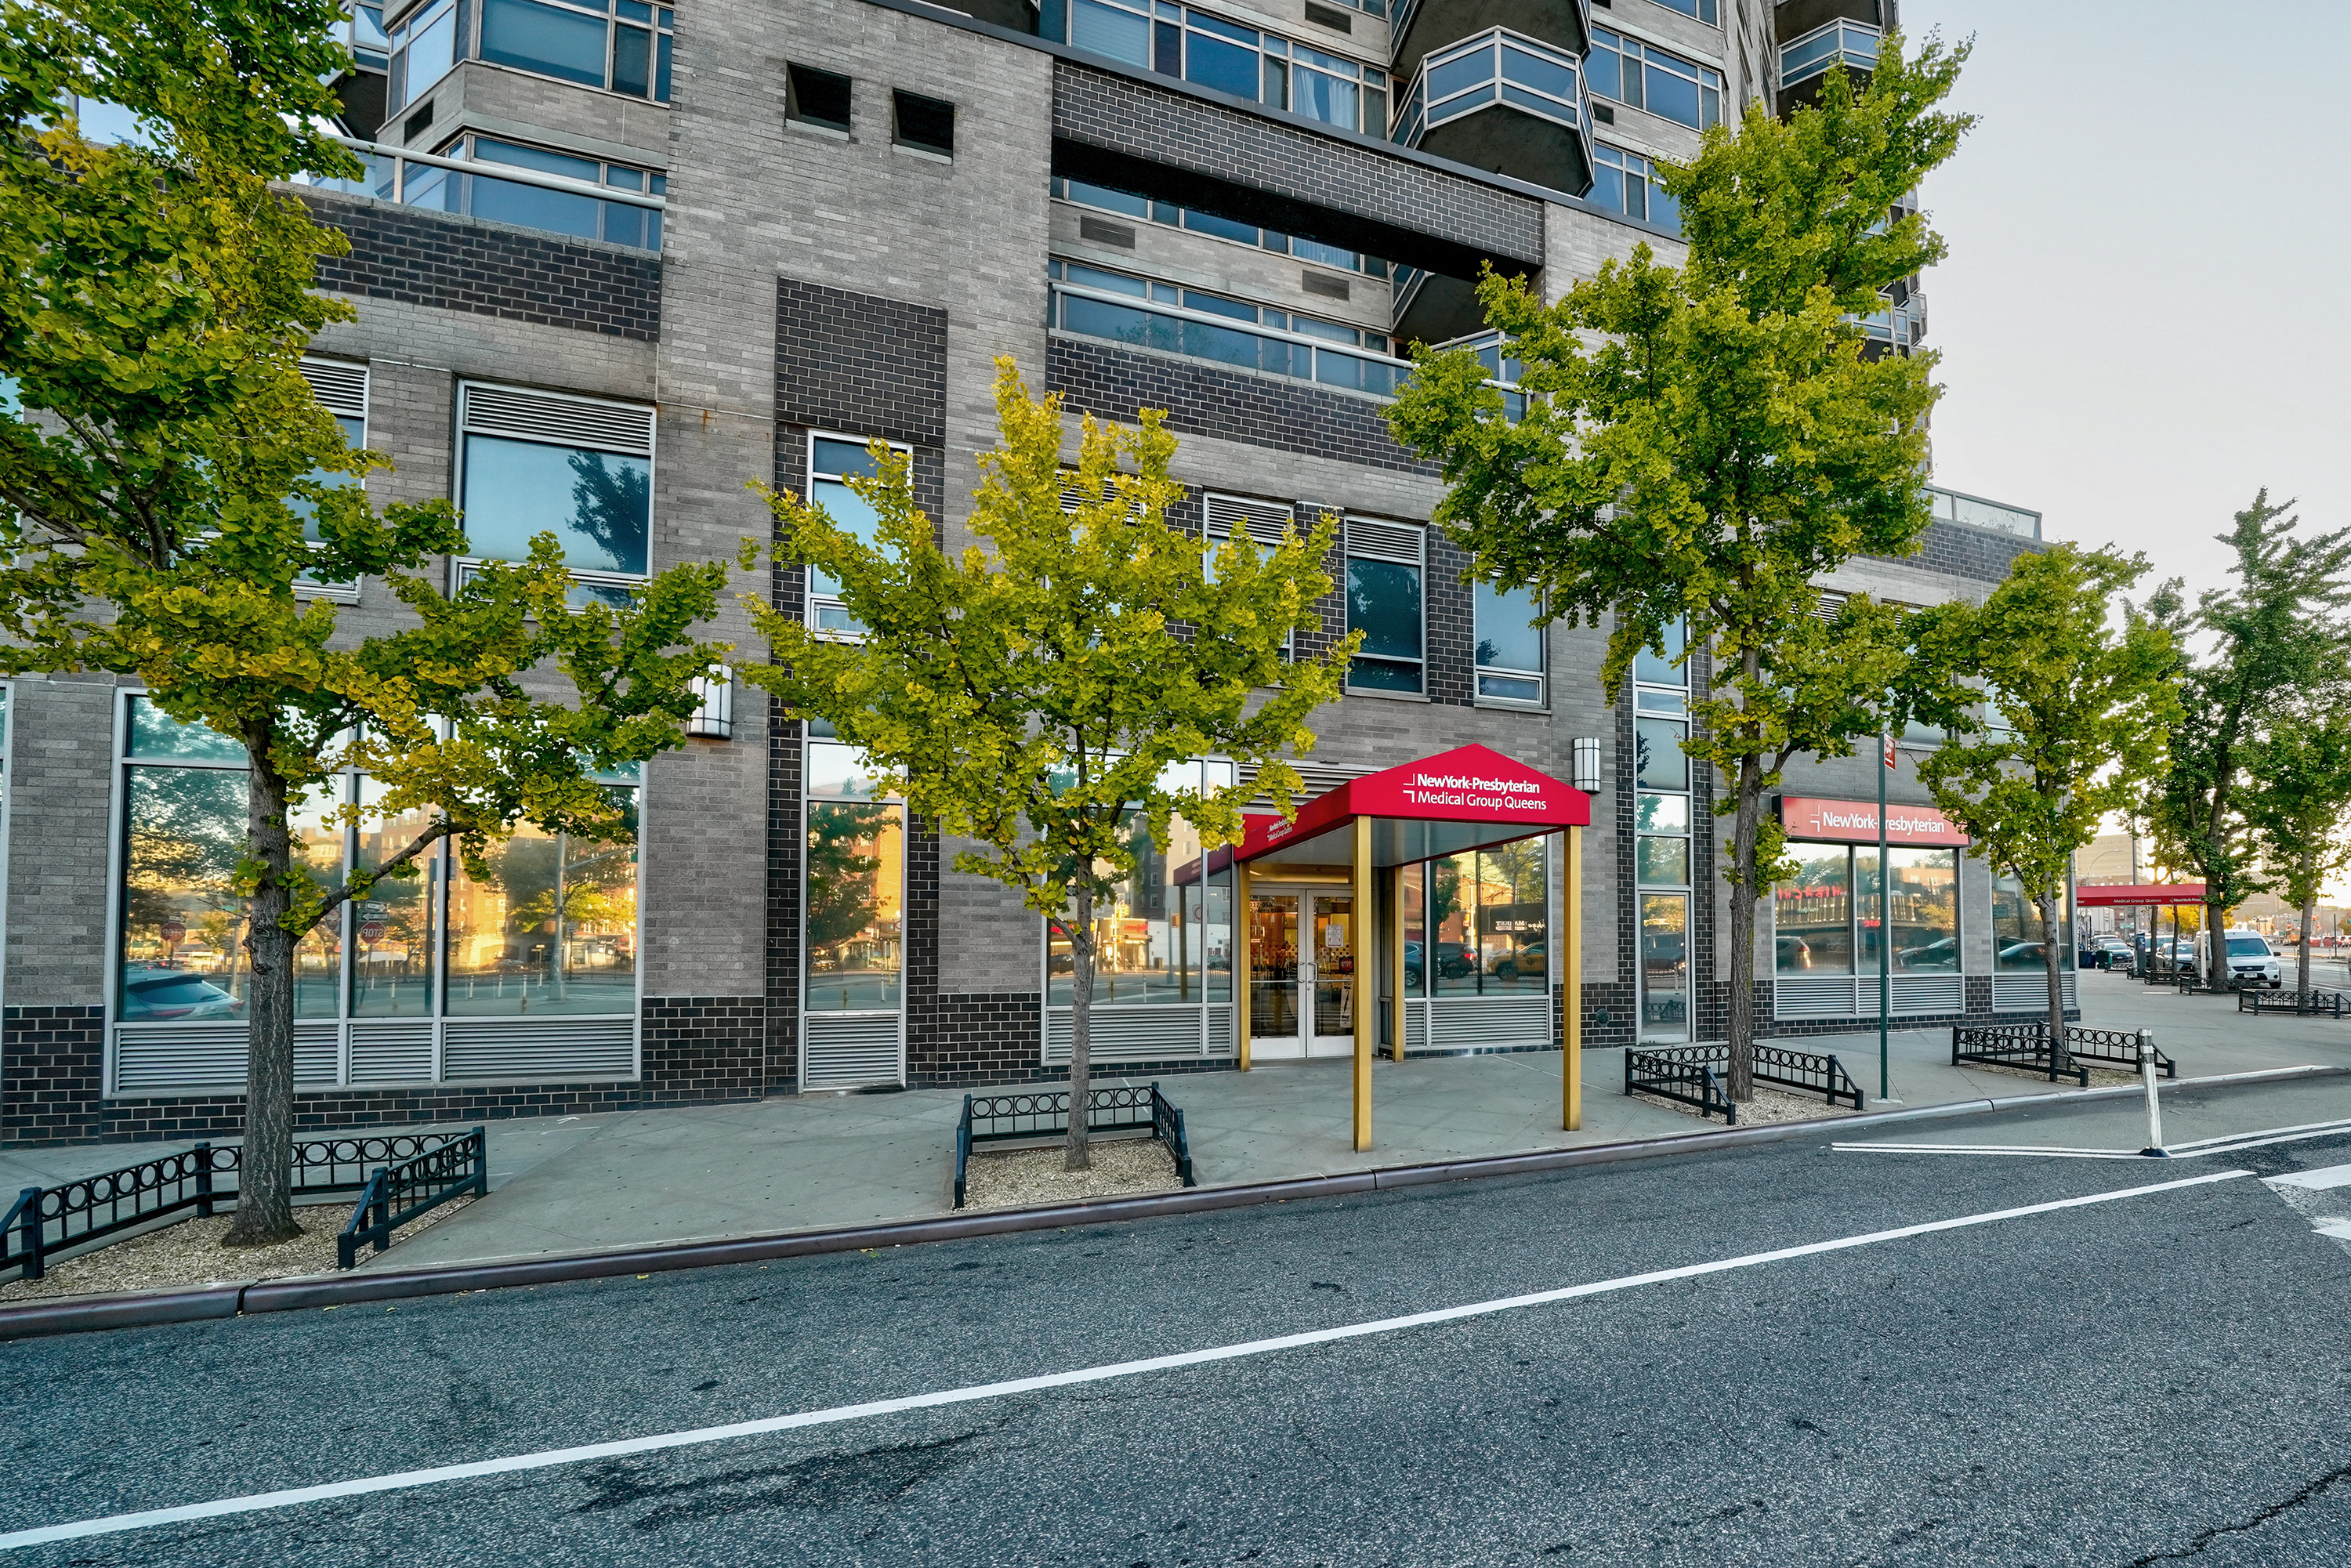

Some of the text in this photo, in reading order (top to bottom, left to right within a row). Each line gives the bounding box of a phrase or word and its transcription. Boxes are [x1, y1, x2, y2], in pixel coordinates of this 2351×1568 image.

[1418, 773, 1540, 795] NewYork-Presbyterian
[1418, 791, 1547, 810] Medical Group Queens
[1823, 811, 1944, 835] NewYork-resbyterian
